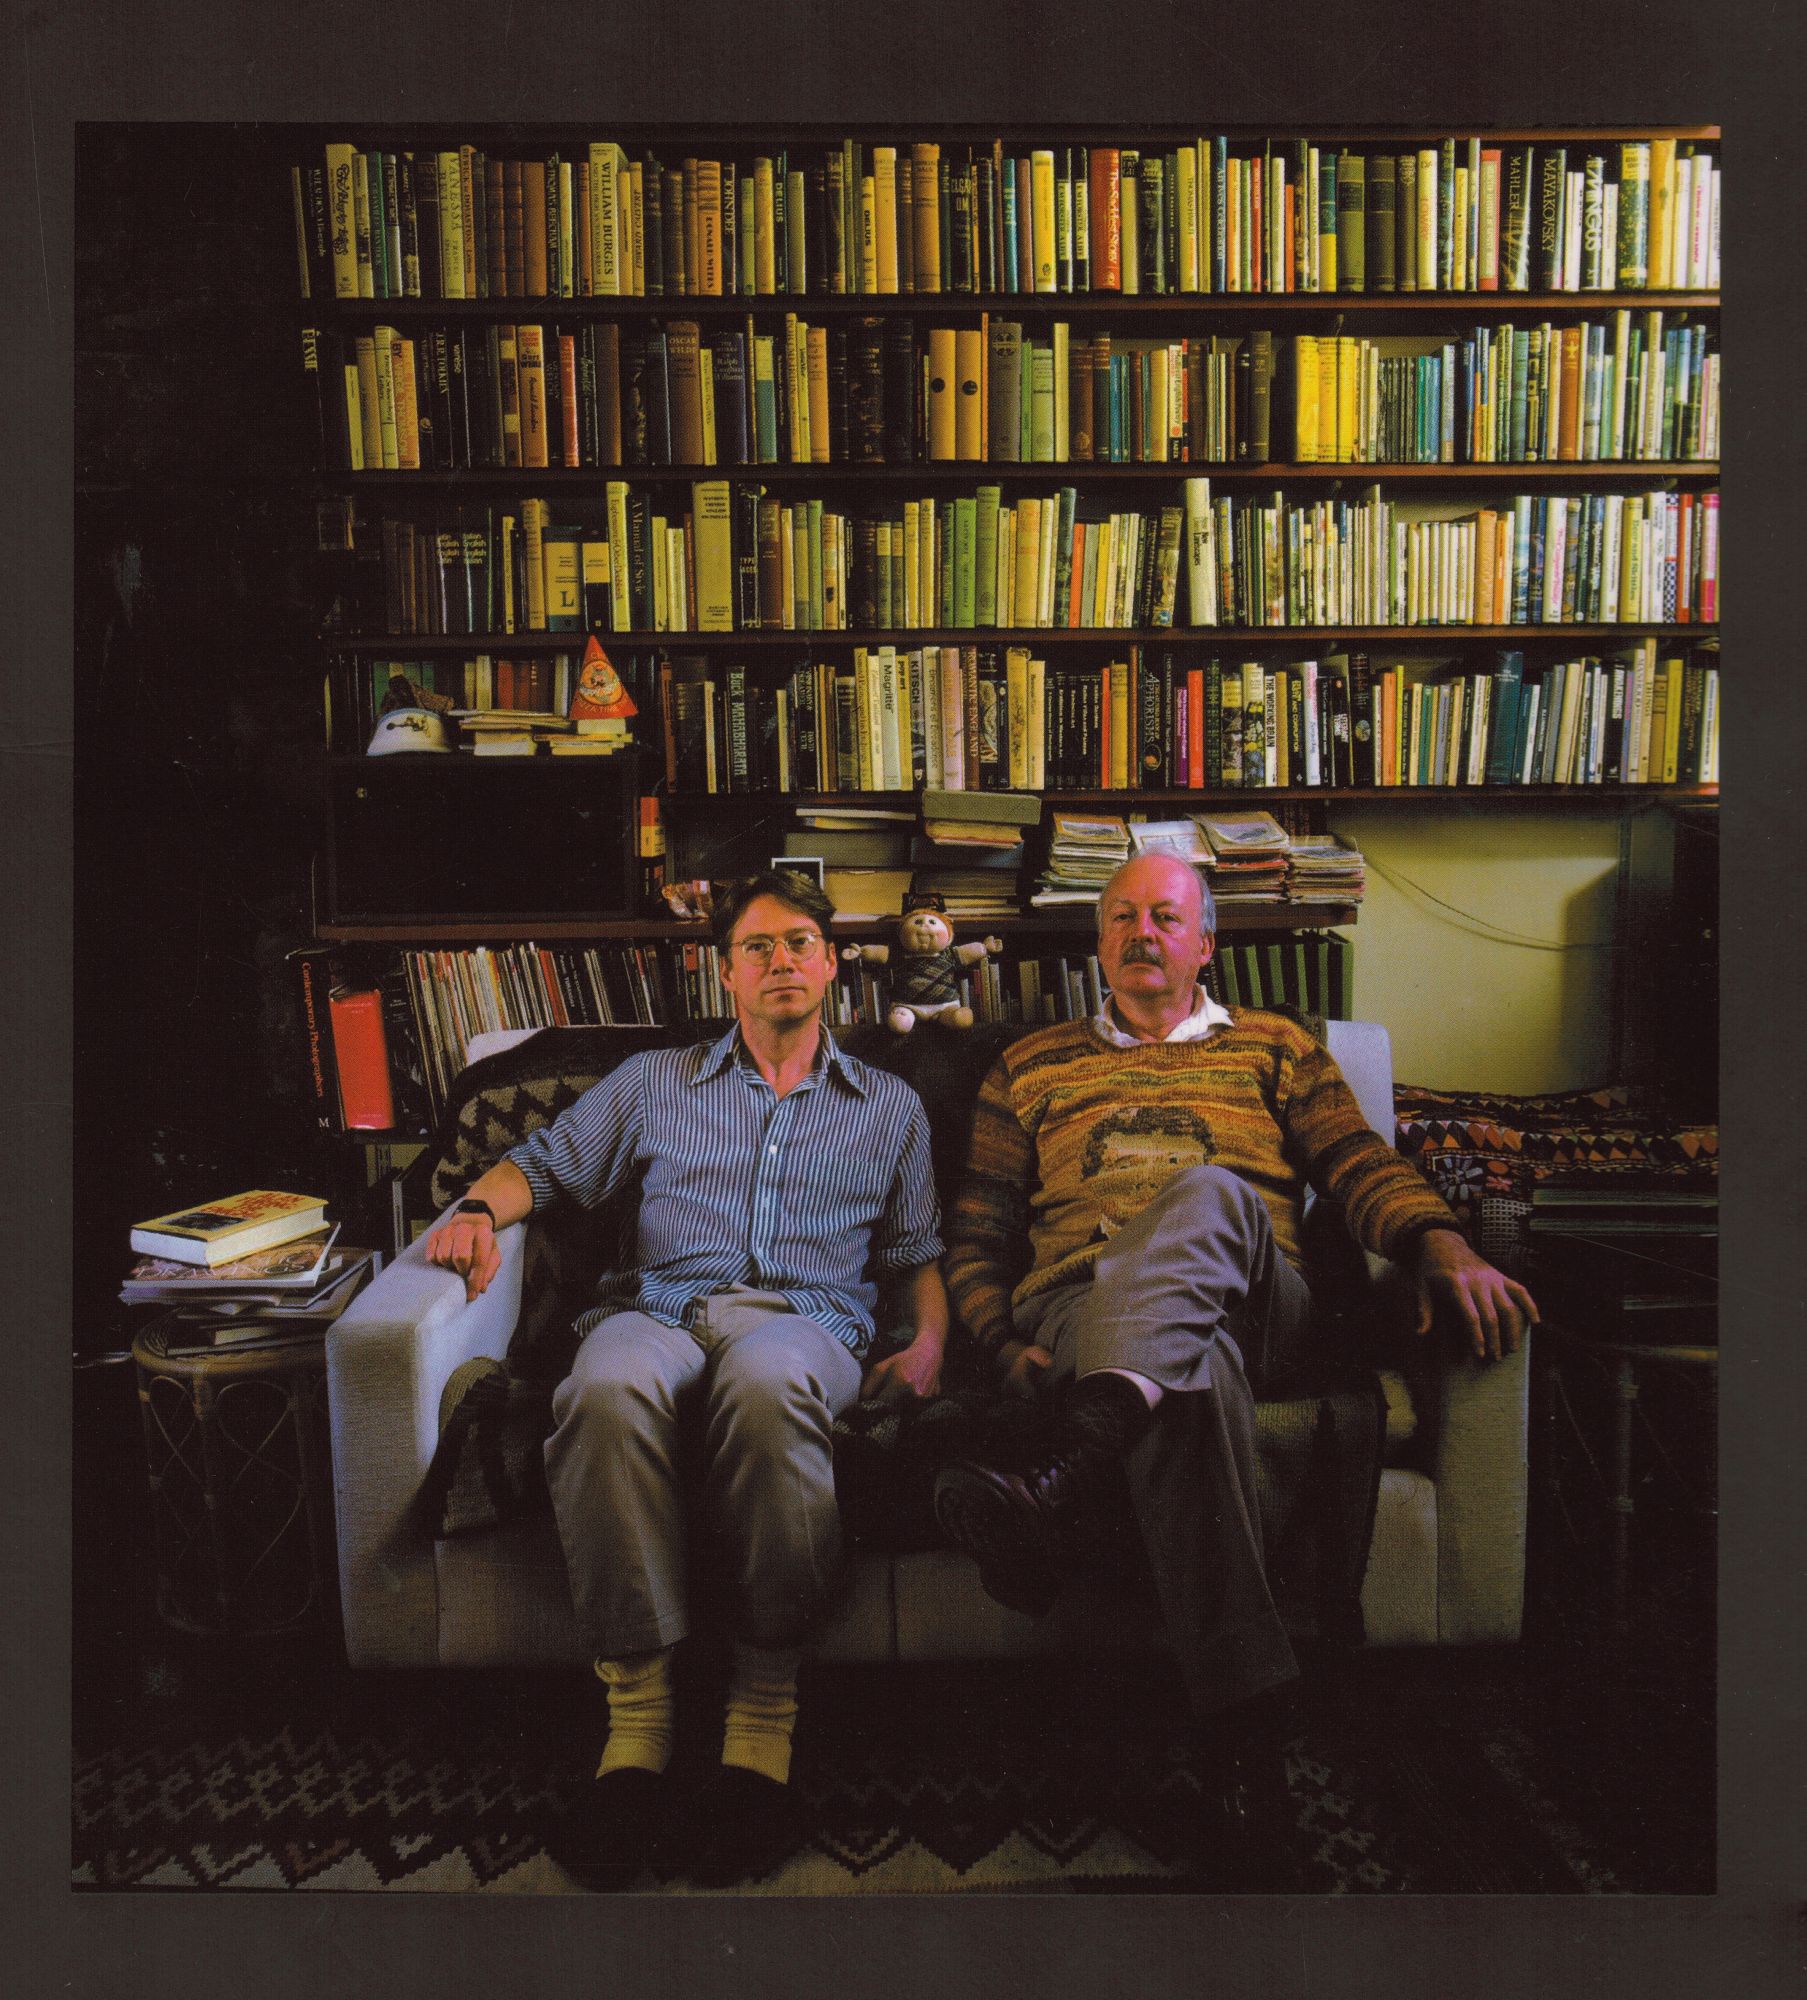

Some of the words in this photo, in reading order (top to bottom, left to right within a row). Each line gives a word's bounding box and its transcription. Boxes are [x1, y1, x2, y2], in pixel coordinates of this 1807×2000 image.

[449, 156, 460, 231] VANESSA
[601, 161, 612, 220] WILLIAM
[775, 181, 784, 223] DELIUS
[1508, 156, 1522, 211] MAHLER
[1107, 188, 1120, 235] Saddest
[1420, 198, 1430, 241] LOWRY
[1542, 158, 1557, 253] MAYAKOVSKY
[1584, 160, 1604, 253] MINGUS
[863, 209, 872, 247] DELIUS
[604, 224, 615, 275] BURGES
[1107, 235, 1120, 264] Story
[392, 343, 402, 358] BY
[438, 357, 449, 395] TOLKIEN
[632, 499, 643, 509] A
[632, 511, 645, 553] Manual
[1193, 531, 1203, 567] Landscapes
[1202, 531, 1210, 545] New
[634, 554, 645, 566] of
[560, 590, 575, 607] L
[634, 568, 646, 595] Style
[882, 664, 894, 711] Magritte
[898, 660, 907, 676] pop
[911, 660, 922, 704] KITSCH
[967, 652, 979, 705] ROMANTIC
[1266, 678, 1276, 691] THE
[1144, 671, 1161, 744] APHORISMS
[1266, 691, 1276, 724] WORKING
[1644, 682, 1654, 718] THINGS
[969, 706, 980, 757] ENGLAND
[1265, 726, 1277, 748] BRAIN
[301, 962, 316, 1031] Contemporary
[308, 1031, 325, 1098] Photographers
[318, 1117, 329, 1128] M
